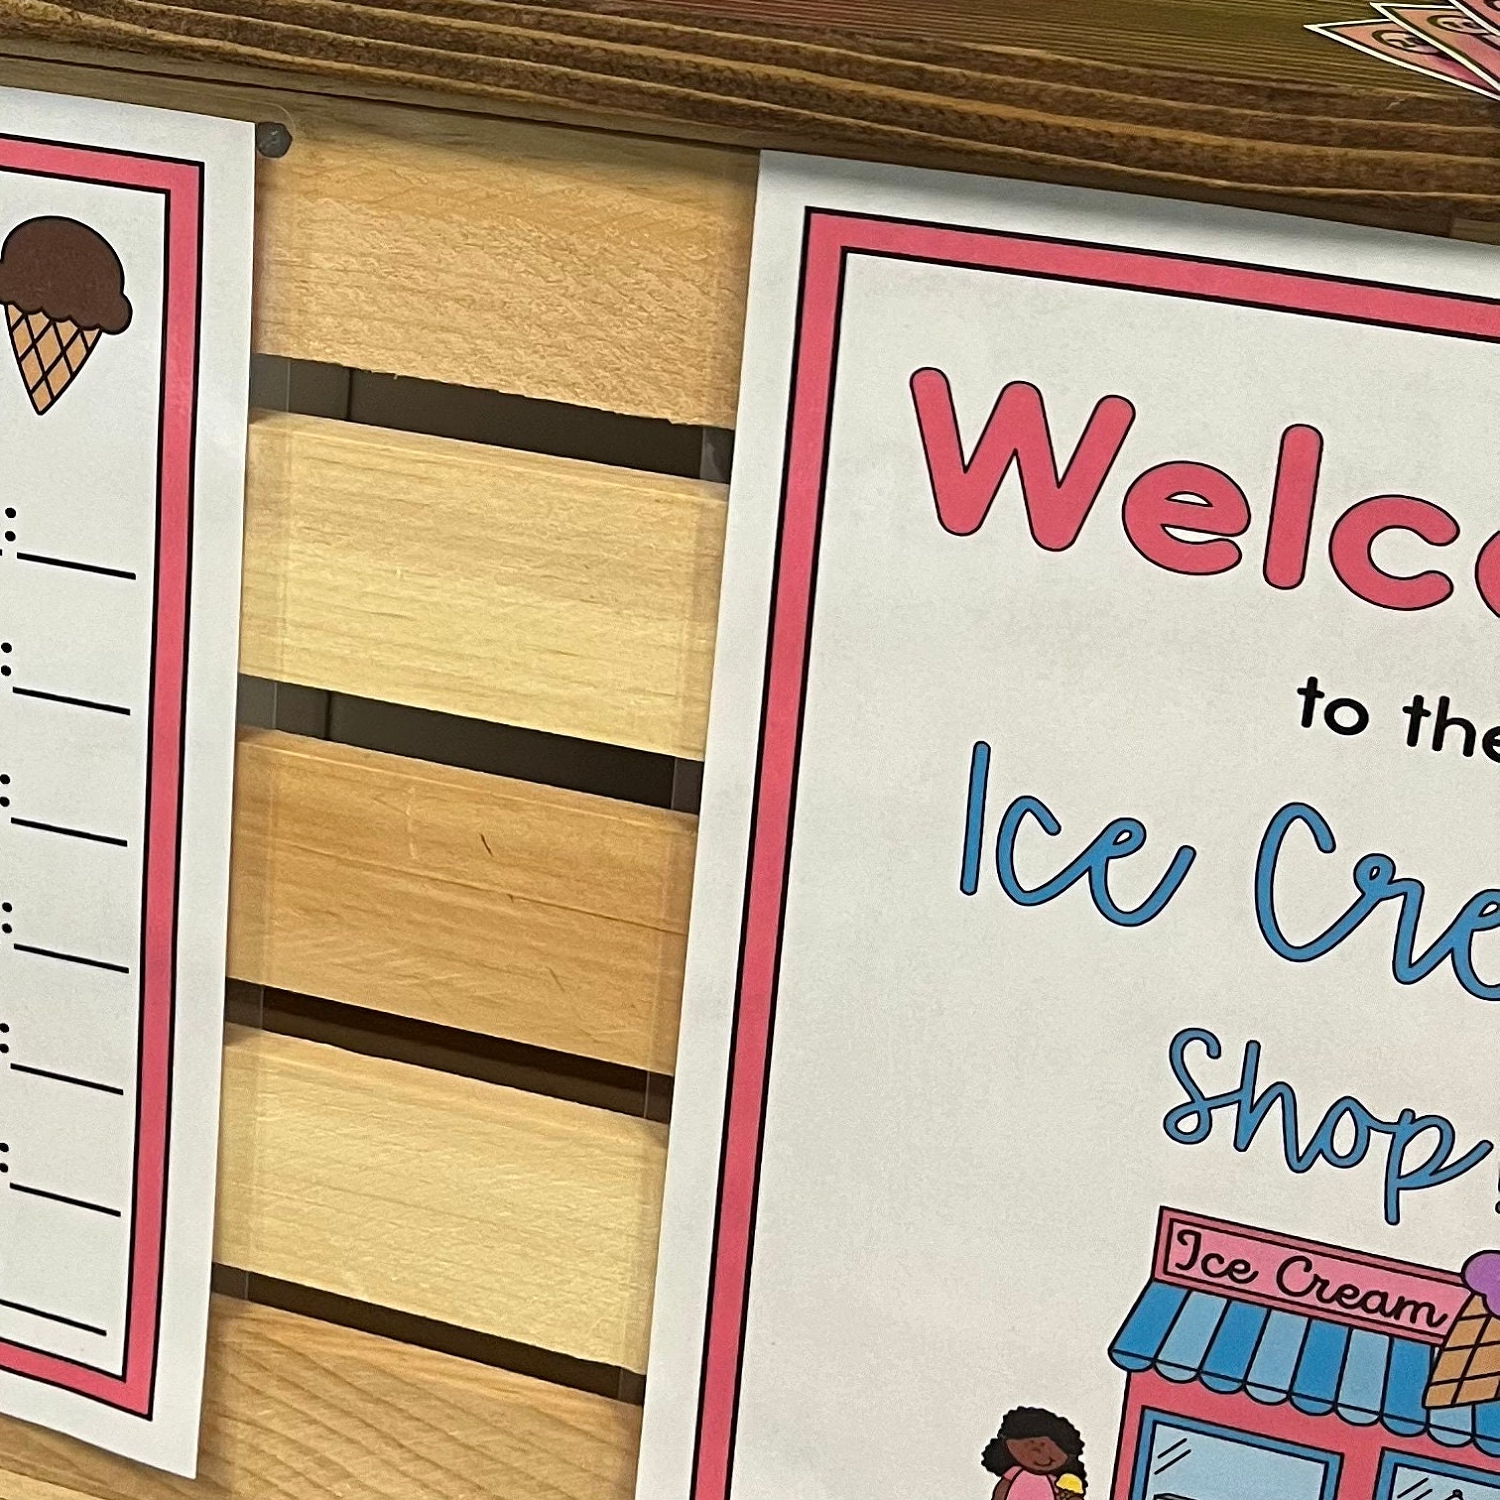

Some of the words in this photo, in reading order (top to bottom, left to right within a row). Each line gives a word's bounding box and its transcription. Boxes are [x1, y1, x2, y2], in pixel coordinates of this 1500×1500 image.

[910, 367, 1500, 618] Welc
[1297, 677, 1369, 735] to
[960, 741, 1196, 927] Ice
[1163, 1028, 1500, 1225] Shop
[1175, 1230, 1259, 1284] Ice
[1276, 1255, 1448, 1328] Cream
